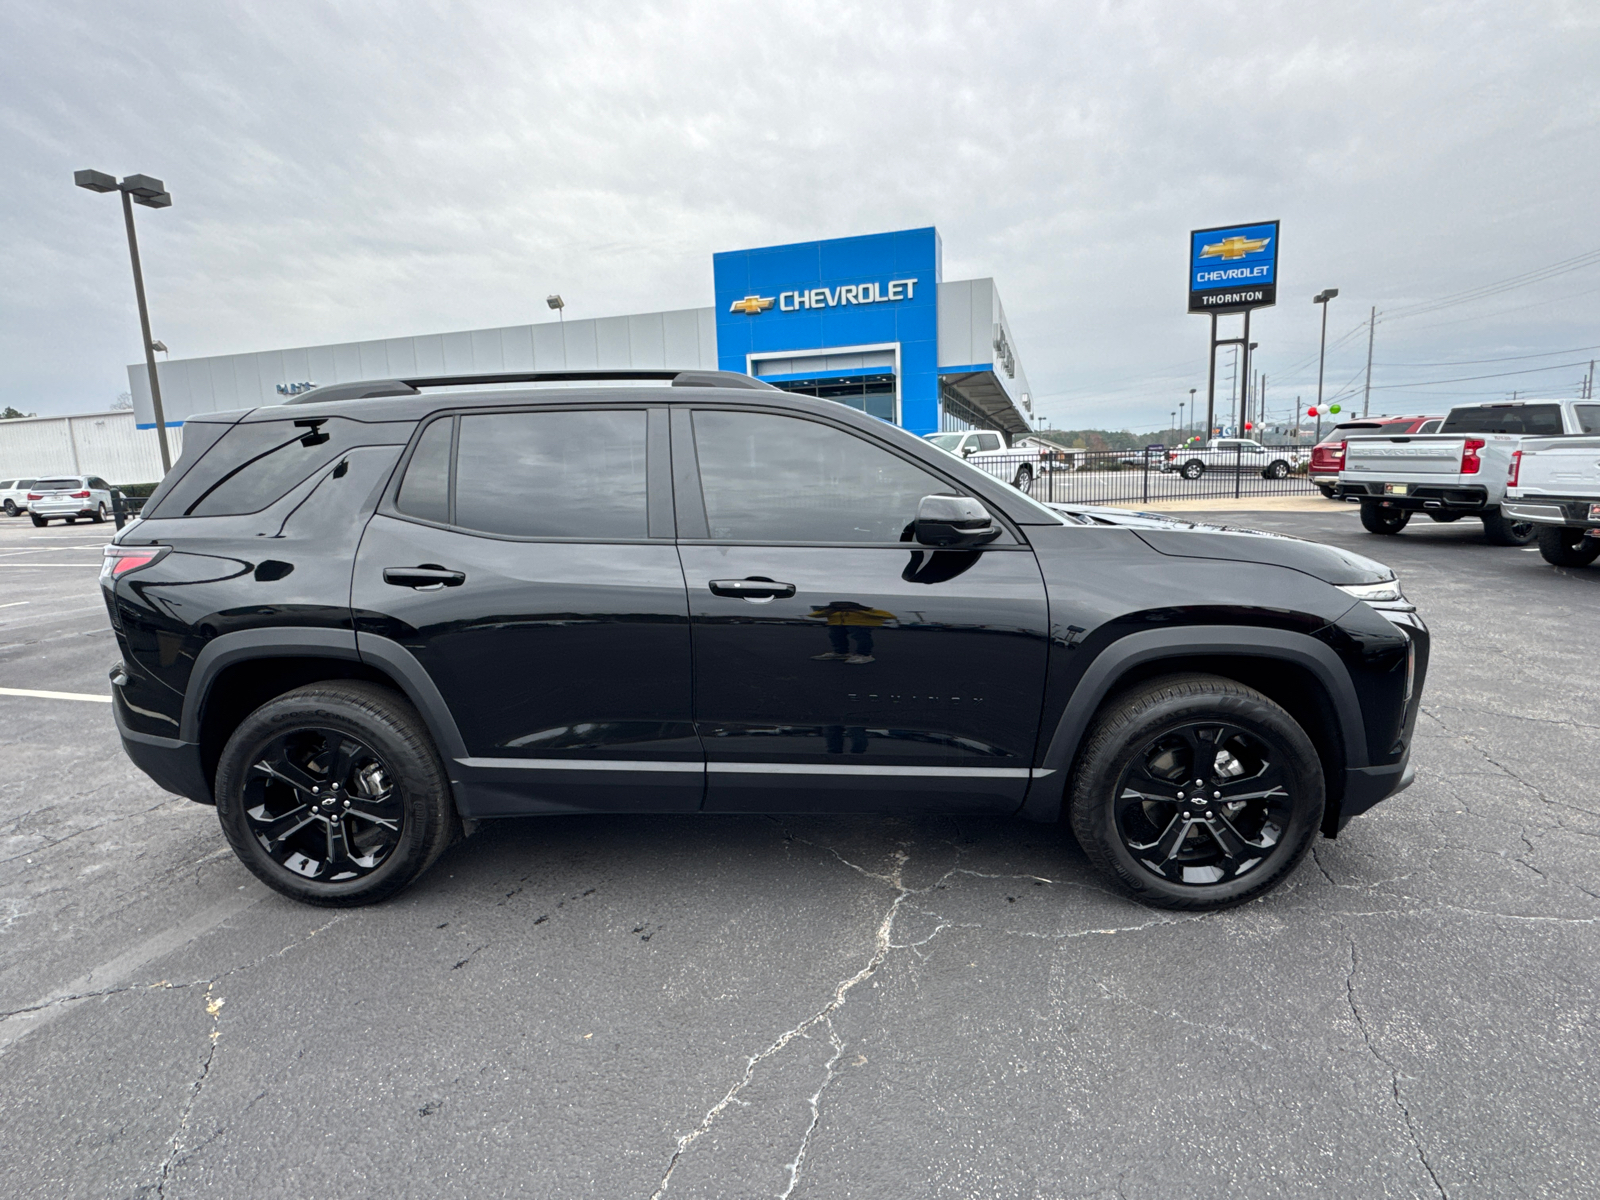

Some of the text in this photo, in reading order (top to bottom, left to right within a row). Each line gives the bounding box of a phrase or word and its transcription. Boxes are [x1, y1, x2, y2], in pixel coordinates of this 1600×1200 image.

[1197, 265, 1270, 282] CHEVROLET
[779, 278, 918, 312] CHEVROLET
[1202, 291, 1263, 305] THORNTON
[1351, 448, 1453, 456] CHEVROLET
